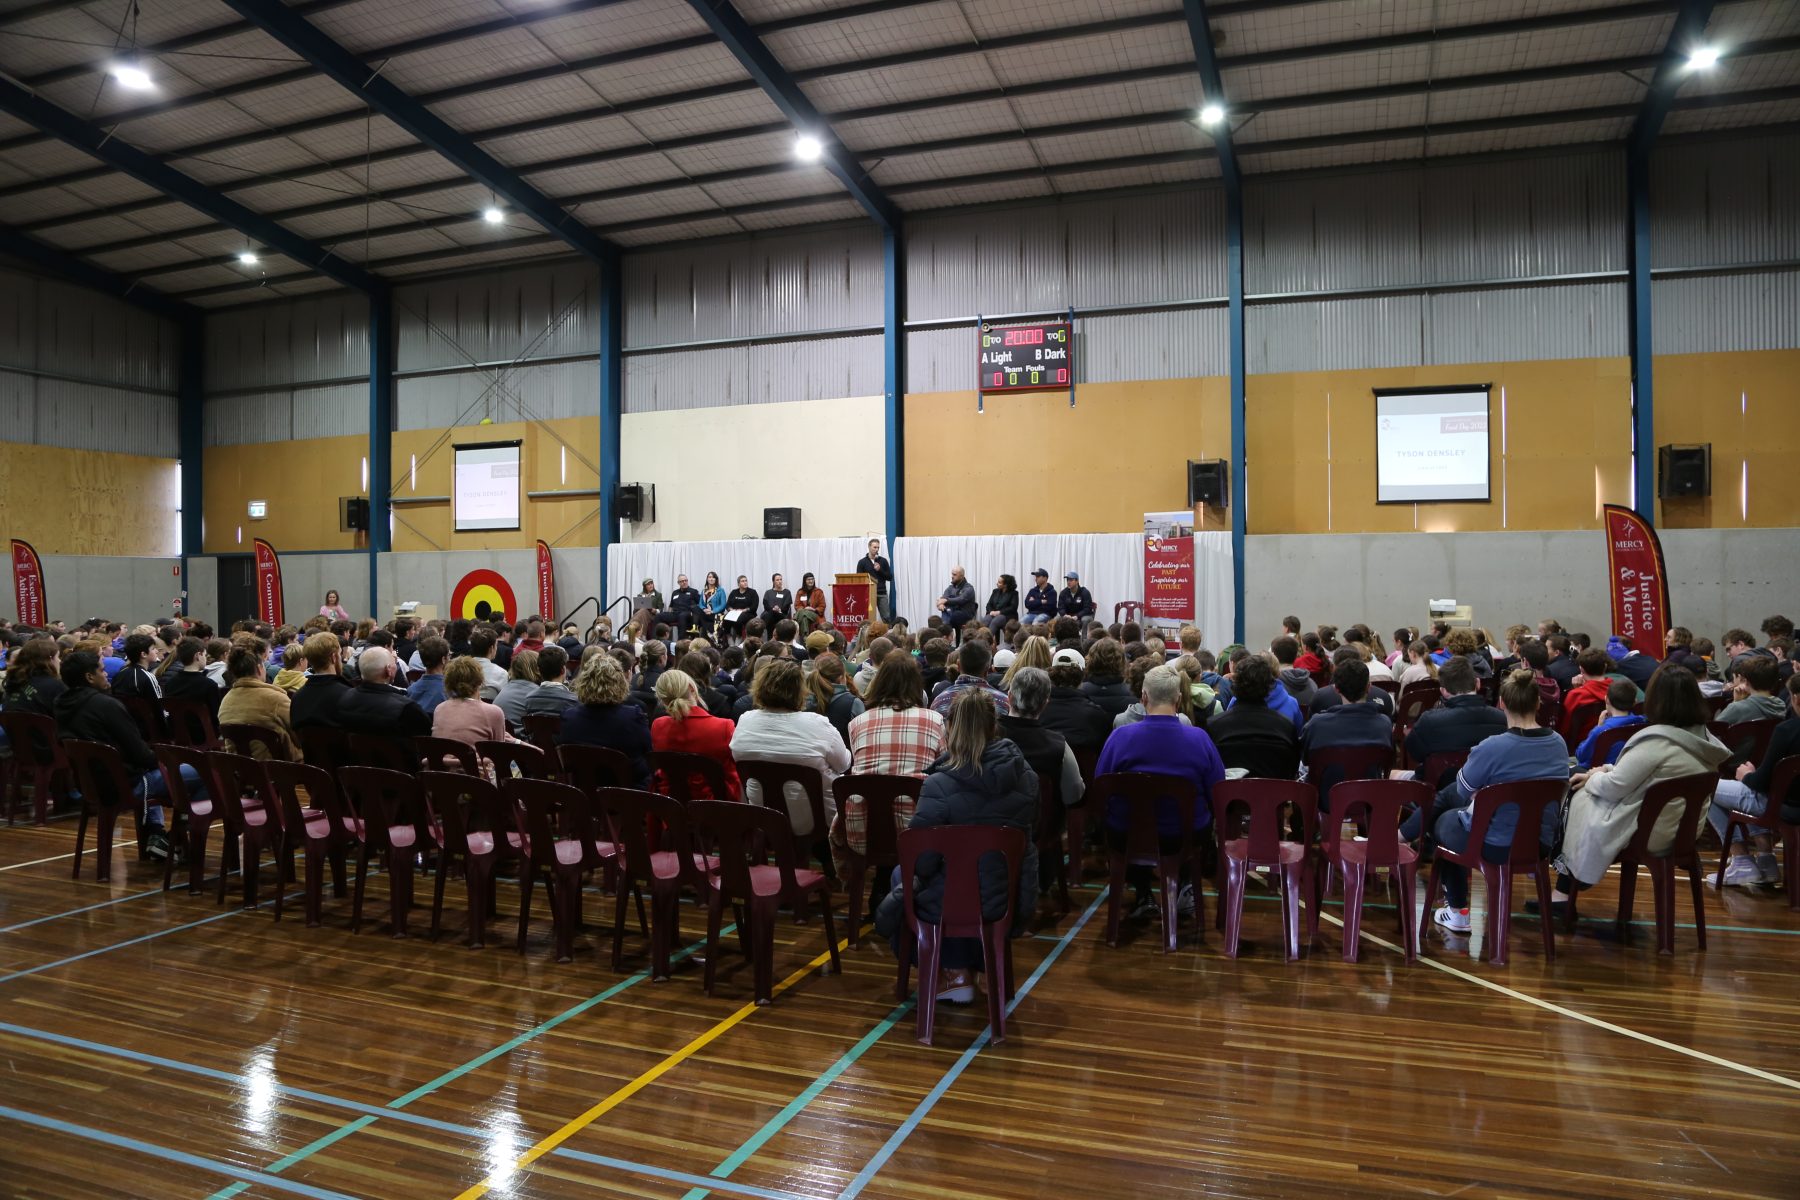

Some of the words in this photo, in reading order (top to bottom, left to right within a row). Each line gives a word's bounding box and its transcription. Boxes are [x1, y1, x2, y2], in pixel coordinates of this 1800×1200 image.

[982, 353, 988, 363] A
[991, 351, 1012, 365] Light
[1035, 349, 1042, 360] B
[1045, 348, 1066, 359] Dark
[1615, 540, 1644, 548] MERCY
[1148, 561, 1179, 570] Celebrating
[1150, 576, 1176, 584] Inspiring
[1620, 567, 1636, 580] &
[29, 574, 38, 624] Excellence
[266, 573, 276, 628] Communi
[1639, 572, 1655, 630] Justice
[837, 614, 865, 623] MERCY
[1622, 586, 1636, 638] Mercy
